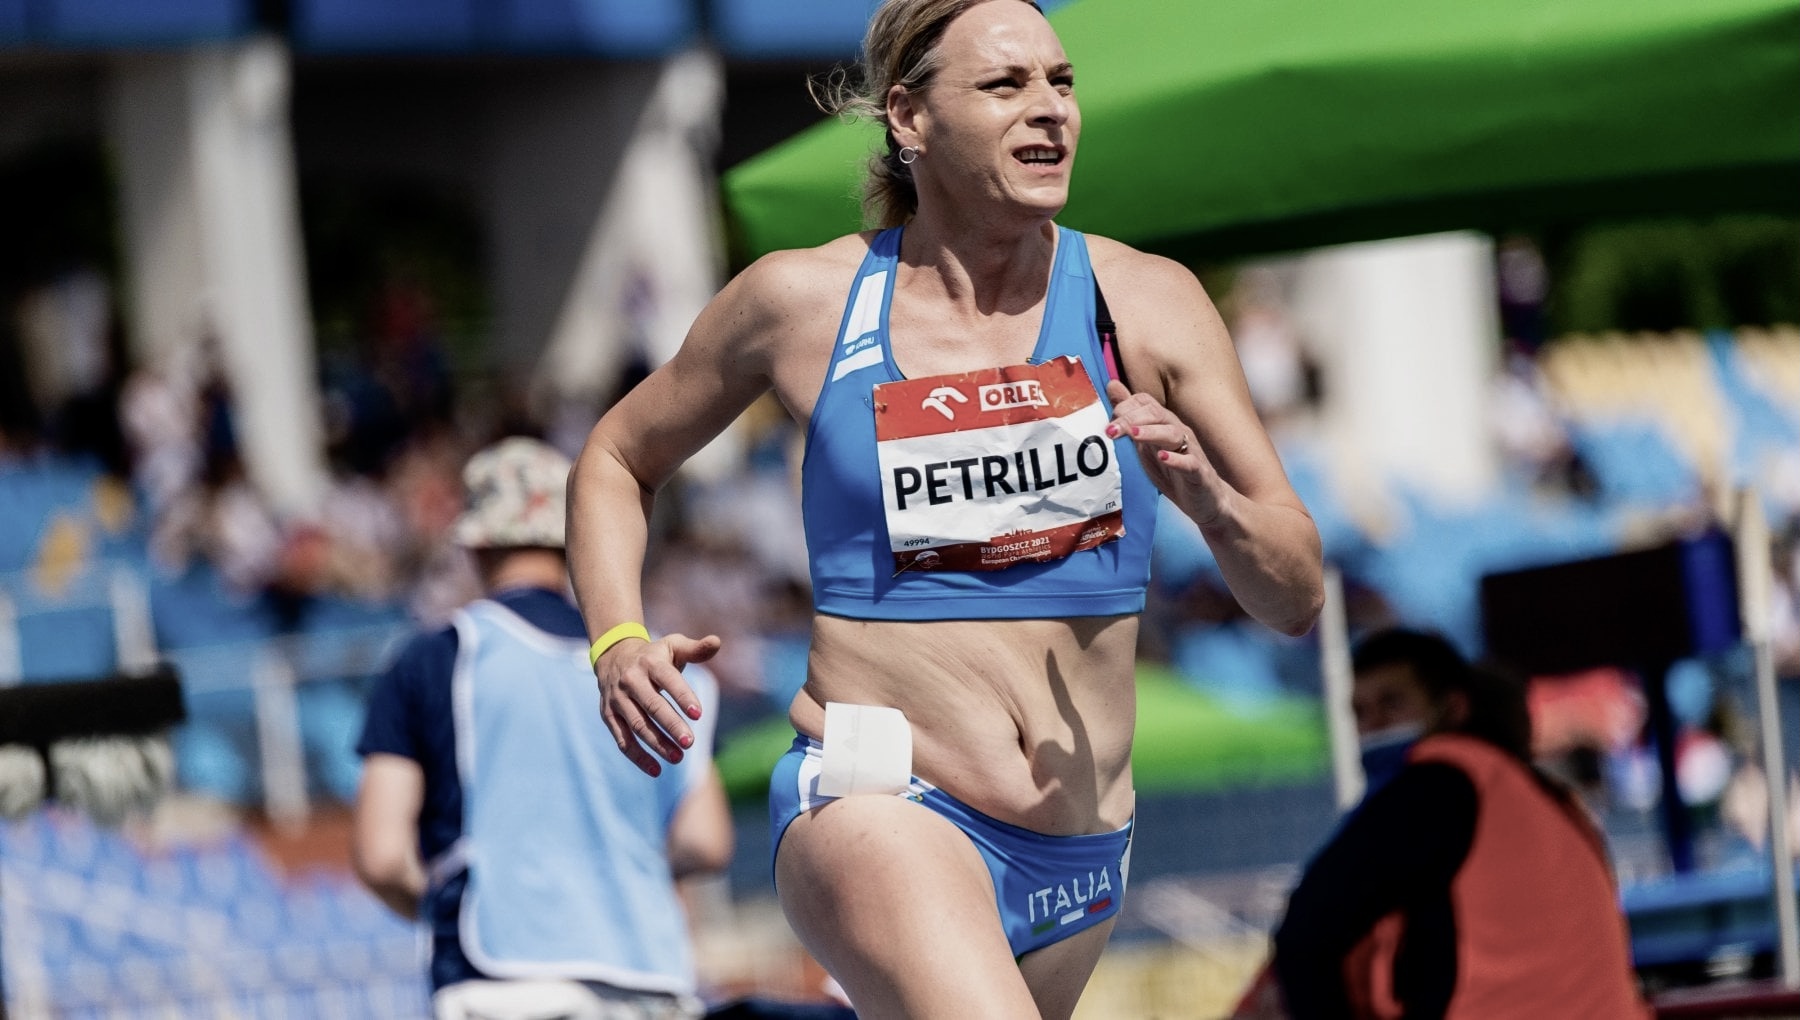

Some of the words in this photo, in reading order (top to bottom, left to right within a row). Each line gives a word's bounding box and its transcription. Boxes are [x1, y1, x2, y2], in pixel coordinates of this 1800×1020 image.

[893, 435, 1109, 511] PETRILLO
[1105, 500, 1117, 510] ITA
[903, 538, 930, 547] 49994
[981, 540, 1030, 554] BYDGOSZCZ
[1031, 536, 1050, 547] 2021
[1028, 866, 1112, 923] ITALIA
